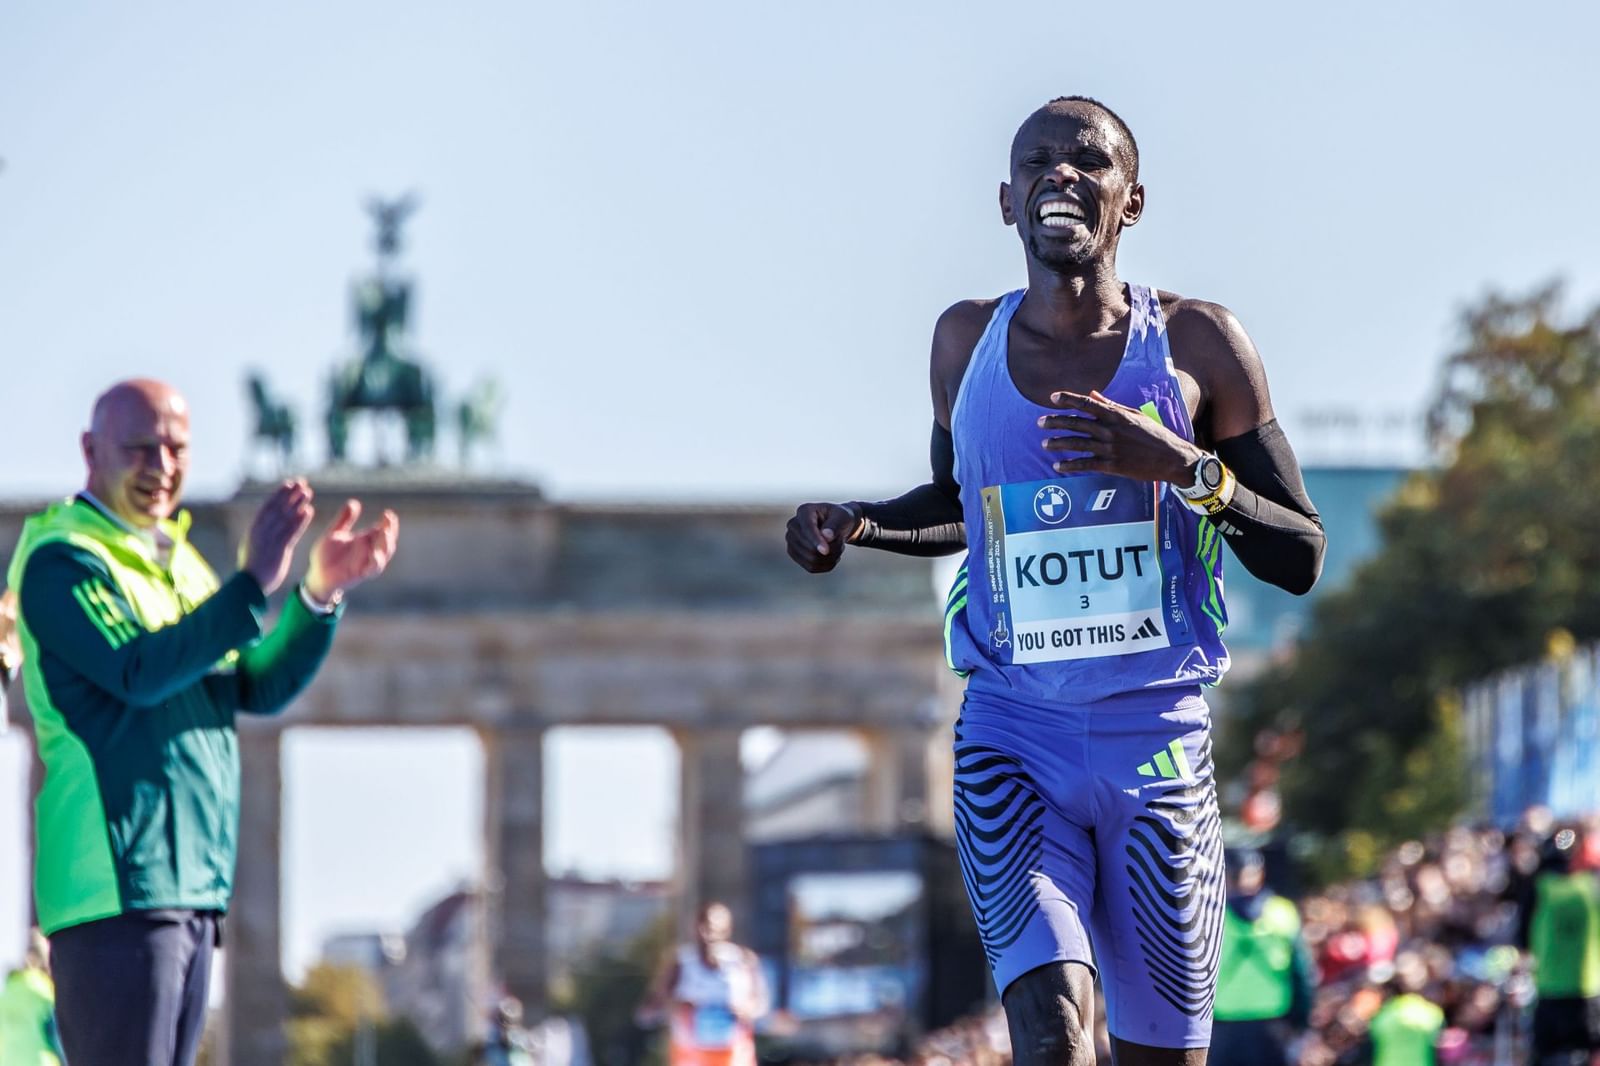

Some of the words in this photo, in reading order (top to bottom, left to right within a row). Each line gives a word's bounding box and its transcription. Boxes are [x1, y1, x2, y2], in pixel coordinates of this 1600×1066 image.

[1037, 487, 1065, 500] BMW
[996, 558, 1004, 591] September
[1015, 545, 1148, 588] KOTUT
[1080, 595, 1090, 609] 3
[1017, 631, 1045, 651] YOU
[1051, 628, 1083, 648] GOT
[1087, 625, 1126, 644] THIS
